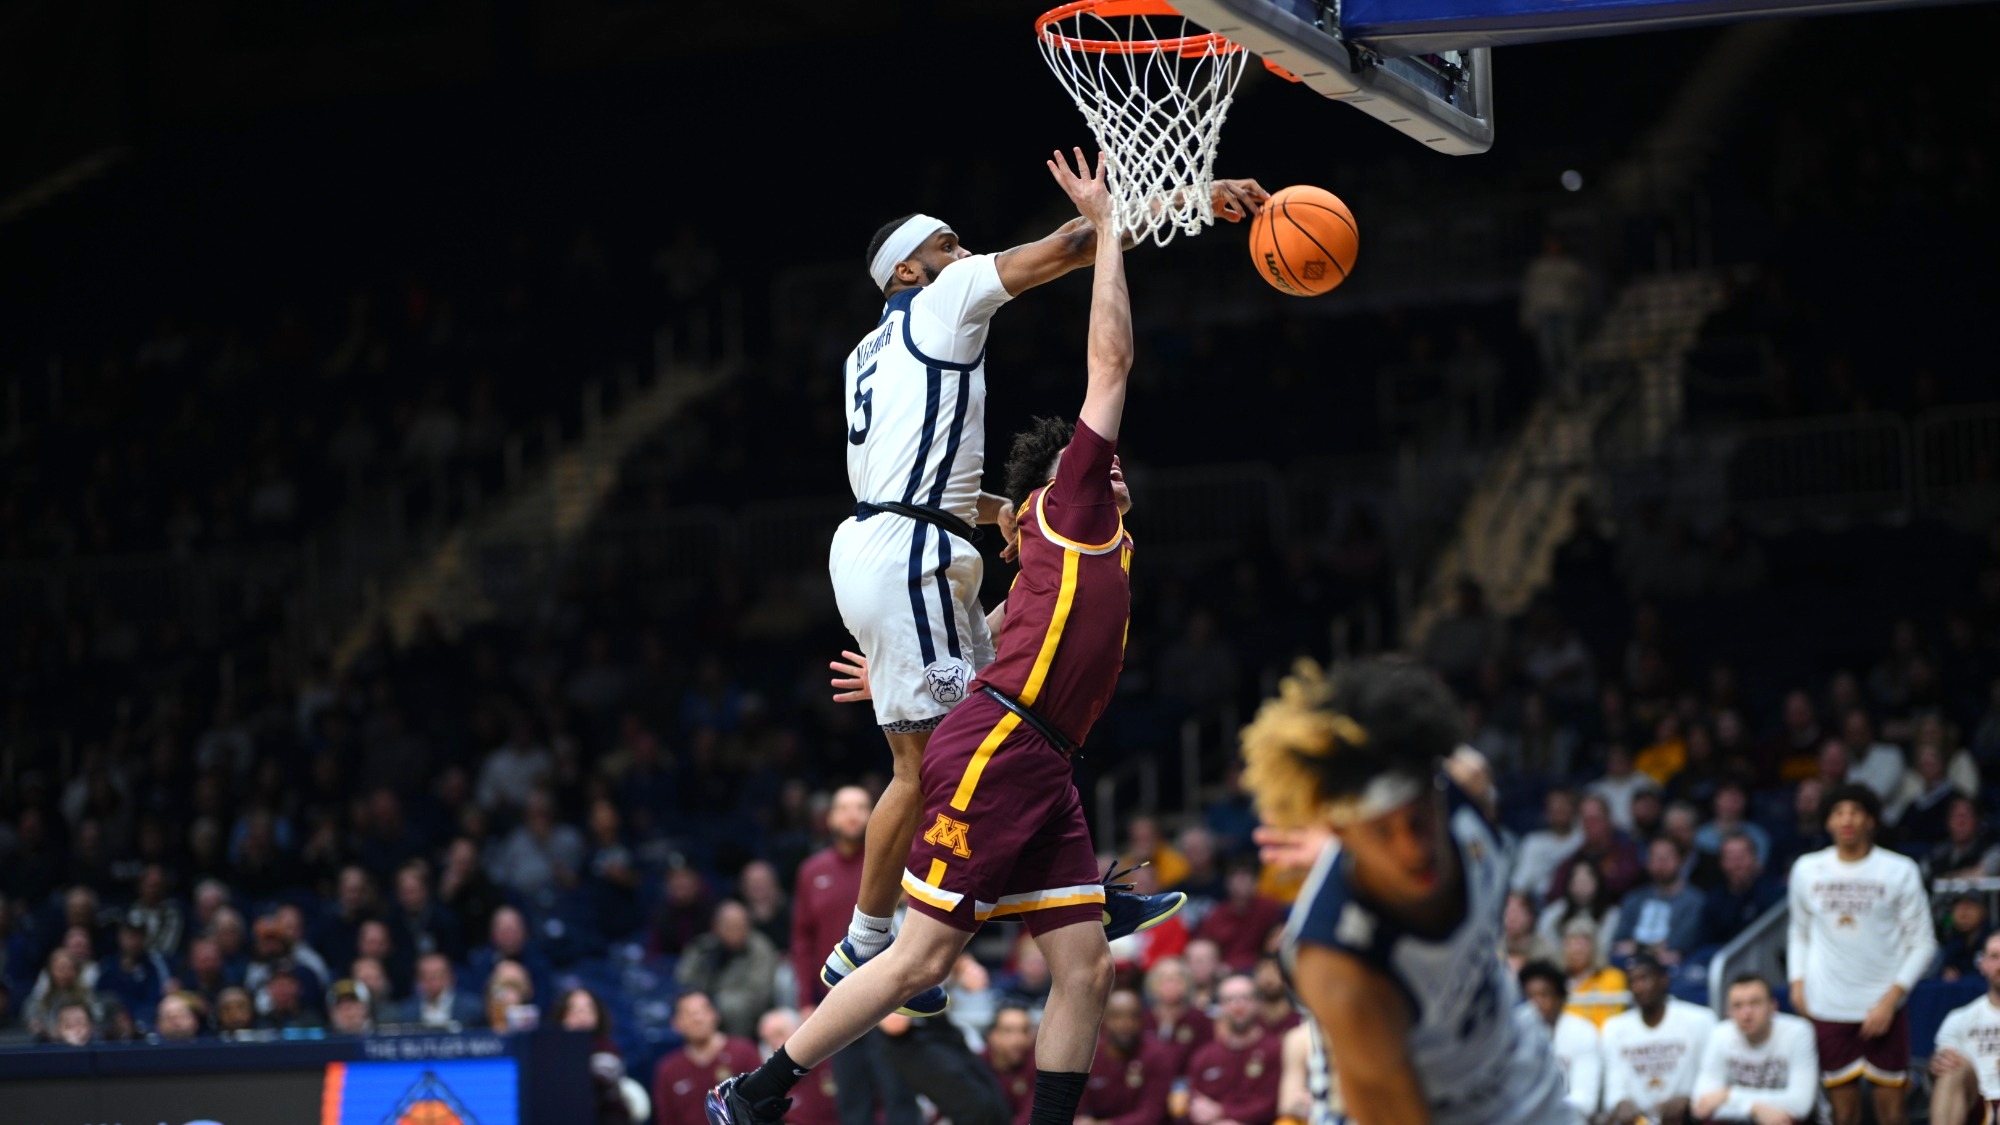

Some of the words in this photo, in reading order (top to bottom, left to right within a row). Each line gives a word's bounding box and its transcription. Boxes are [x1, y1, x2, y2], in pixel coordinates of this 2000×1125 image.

[856, 321, 894, 373] ALEXANDER
[849, 360, 878, 446] 5
[923, 813, 972, 859] M
